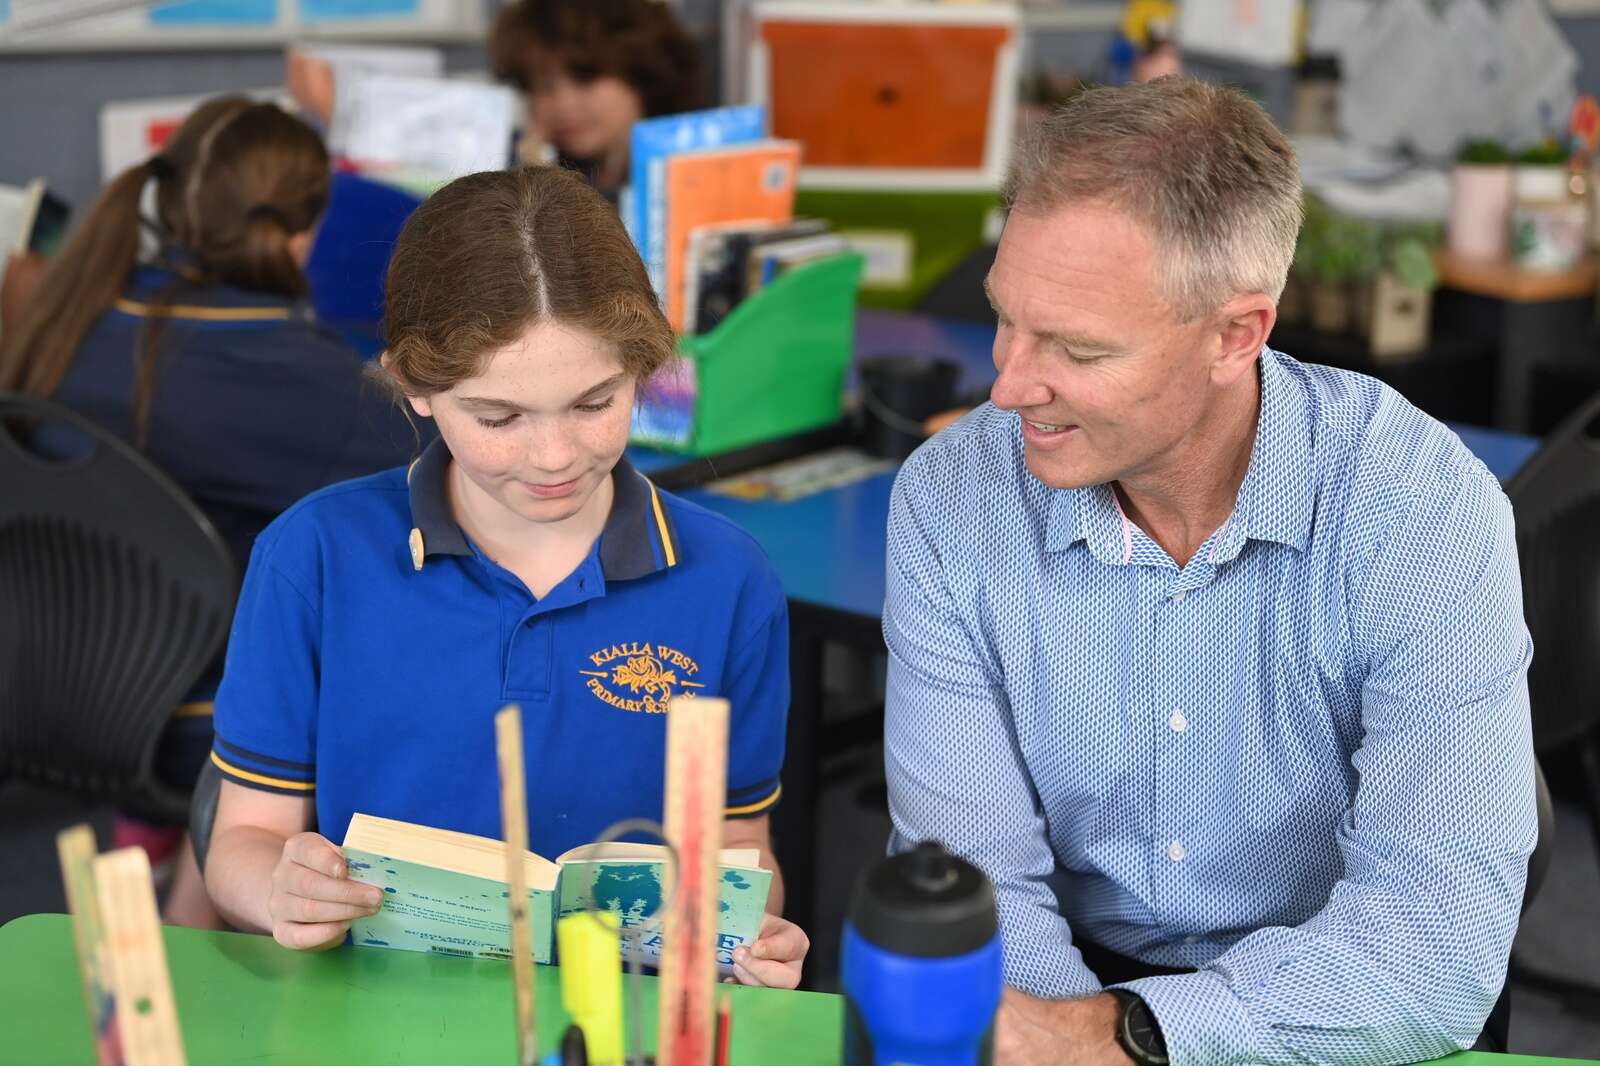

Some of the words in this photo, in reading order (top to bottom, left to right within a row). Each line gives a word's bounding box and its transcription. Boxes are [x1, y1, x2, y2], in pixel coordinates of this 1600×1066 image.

[589, 642, 654, 667] KIALLA
[657, 644, 699, 676] WEST
[586, 677, 643, 712] PRIMARY
[646, 690, 697, 713] SCHL
